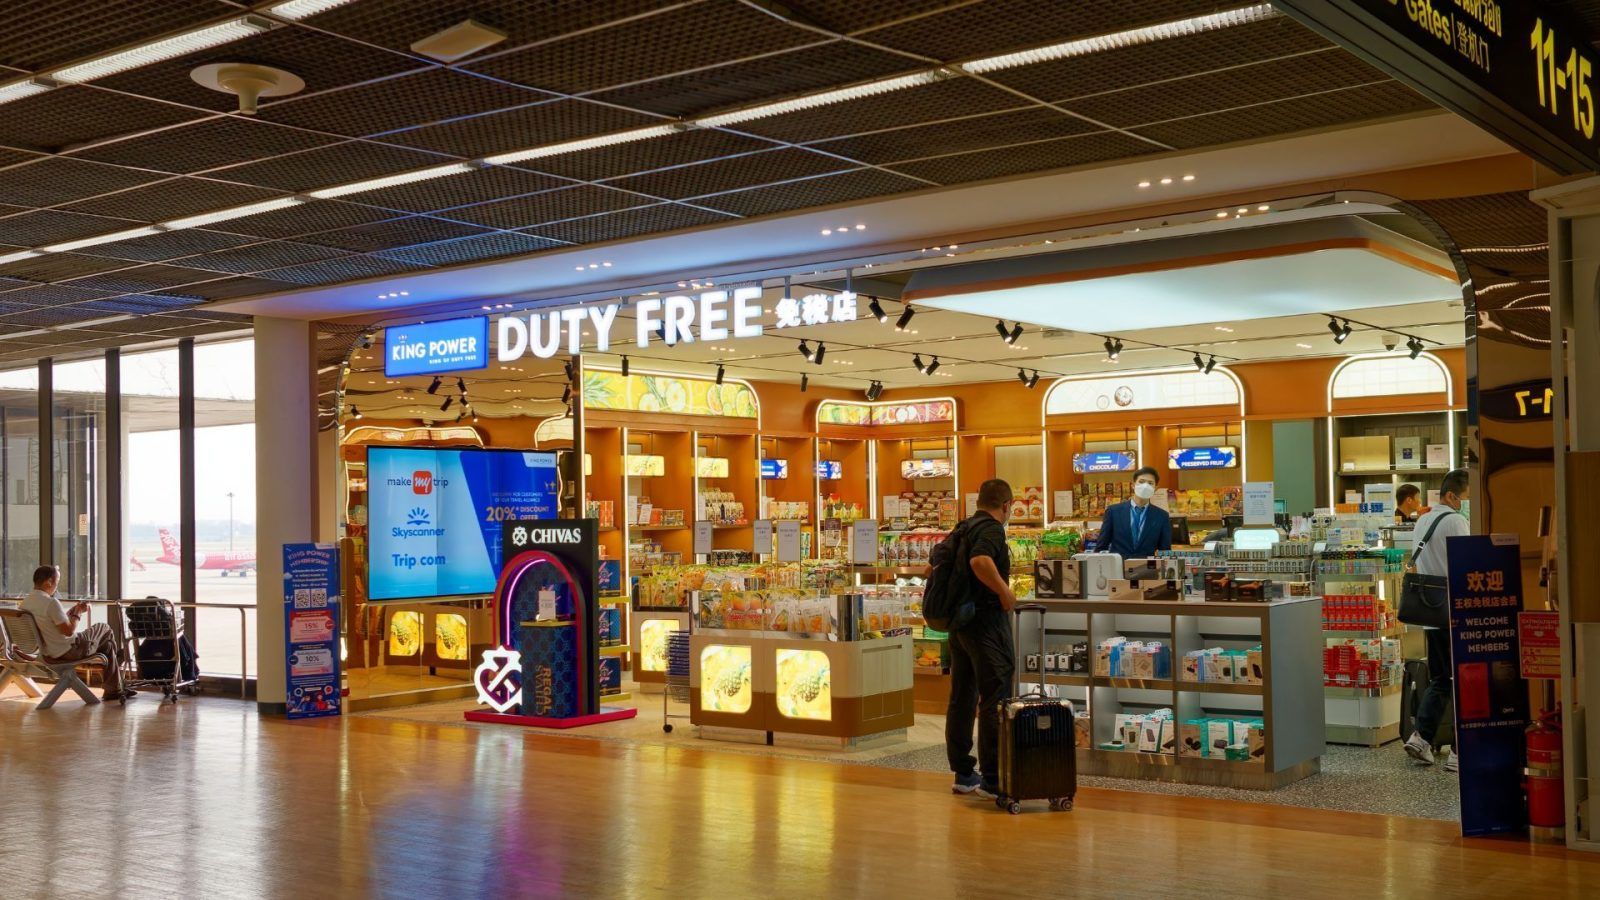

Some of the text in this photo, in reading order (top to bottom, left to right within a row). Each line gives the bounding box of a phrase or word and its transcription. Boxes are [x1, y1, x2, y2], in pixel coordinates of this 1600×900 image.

[1405, 0, 1451, 45] Gates
[1530, 17, 1595, 139] 11-15
[498, 286, 764, 362] DUTY FREE
[392, 336, 477, 361] KING POWER
[387, 476, 449, 493] make my trip
[392, 526, 445, 539] Skyscanner
[531, 528, 581, 544] CHIVAS
[288, 550, 331, 560] KING POWER
[1466, 570, 1505, 592] 欢迎
[1455, 595, 1518, 609] 王权免税店会员
[1465, 616, 1509, 626] WELCOME
[1460, 629, 1516, 640] KING POWER
[1468, 642, 1510, 653] MEMBERS
[544, 668, 552, 713] REGAL
